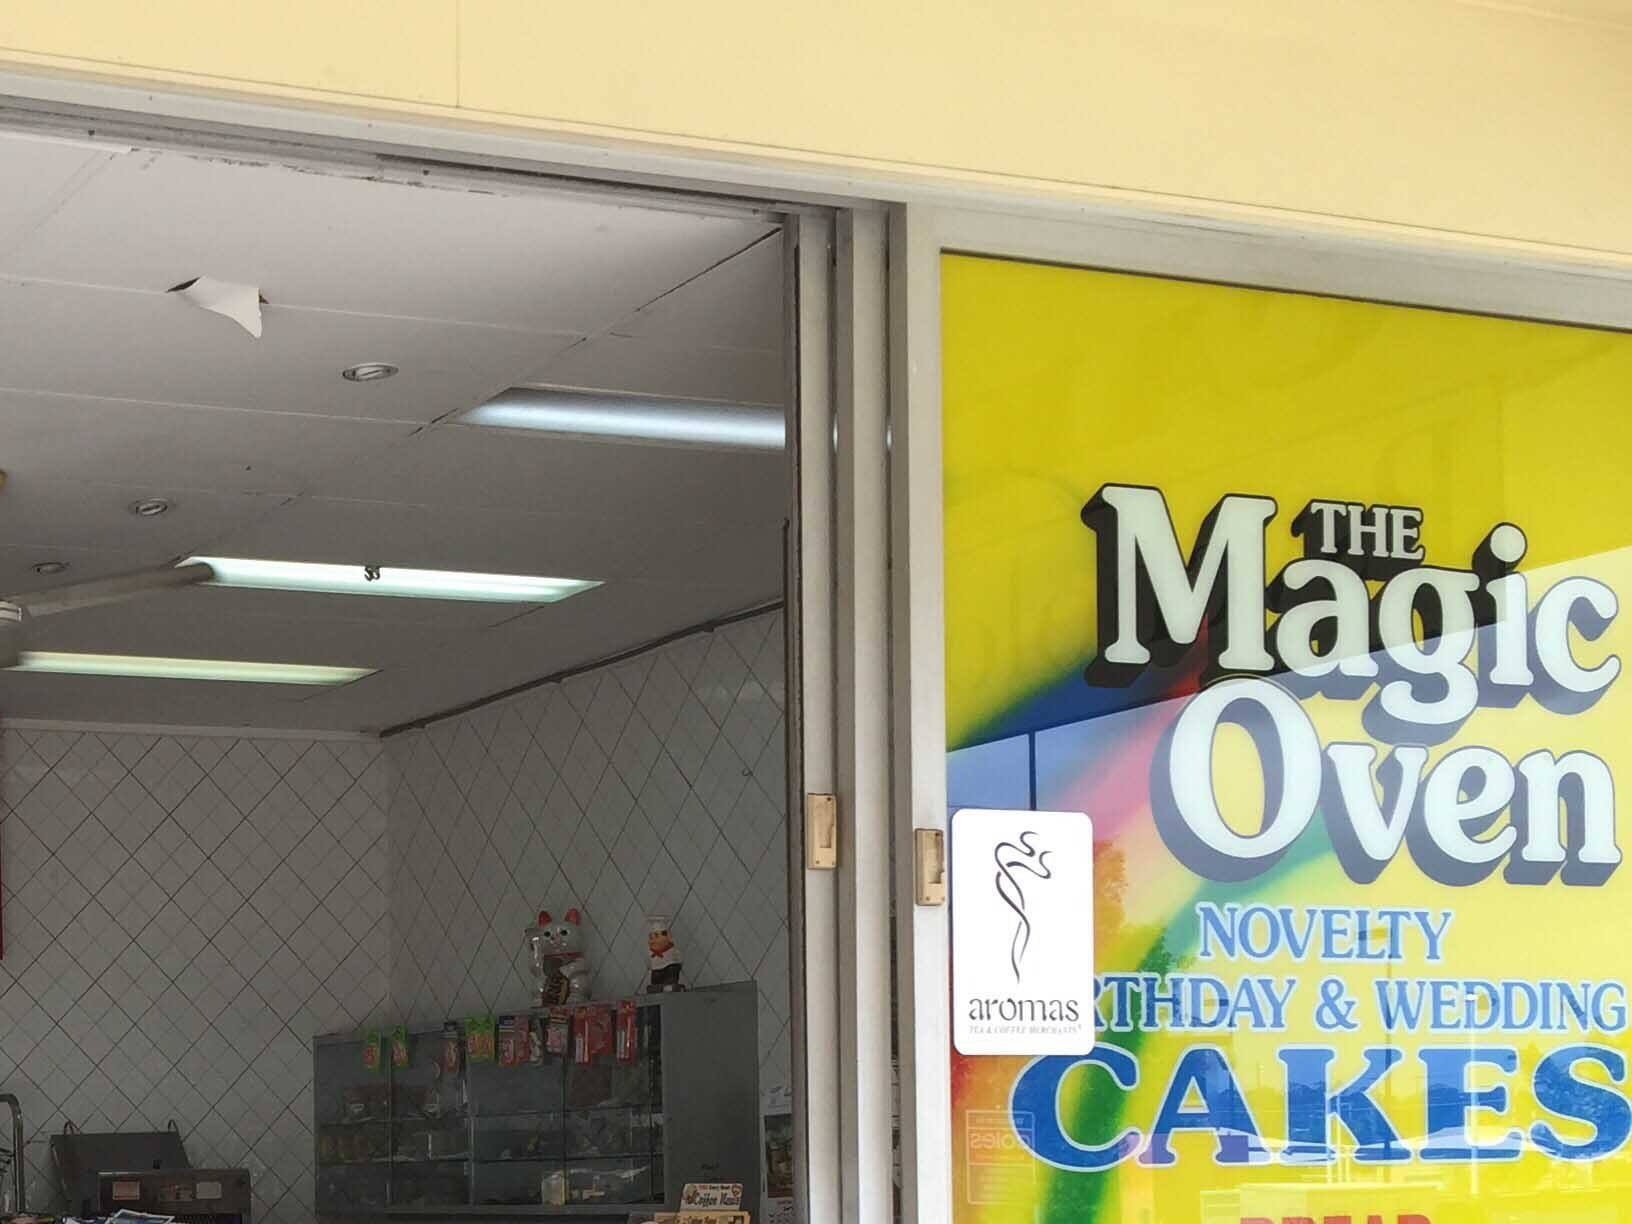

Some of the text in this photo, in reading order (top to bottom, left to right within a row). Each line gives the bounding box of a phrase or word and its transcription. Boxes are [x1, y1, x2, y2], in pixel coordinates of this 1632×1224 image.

[1294, 500, 1426, 570] THE
[1084, 483, 1621, 735] Magic
[1152, 677, 1622, 882] Oven
[1199, 906, 1453, 960] NOVELTY
[968, 997, 1079, 1022] aromas
[1094, 976, 1627, 1031] THDAY & WEDDING
[1010, 1045, 1632, 1170] CAKES
